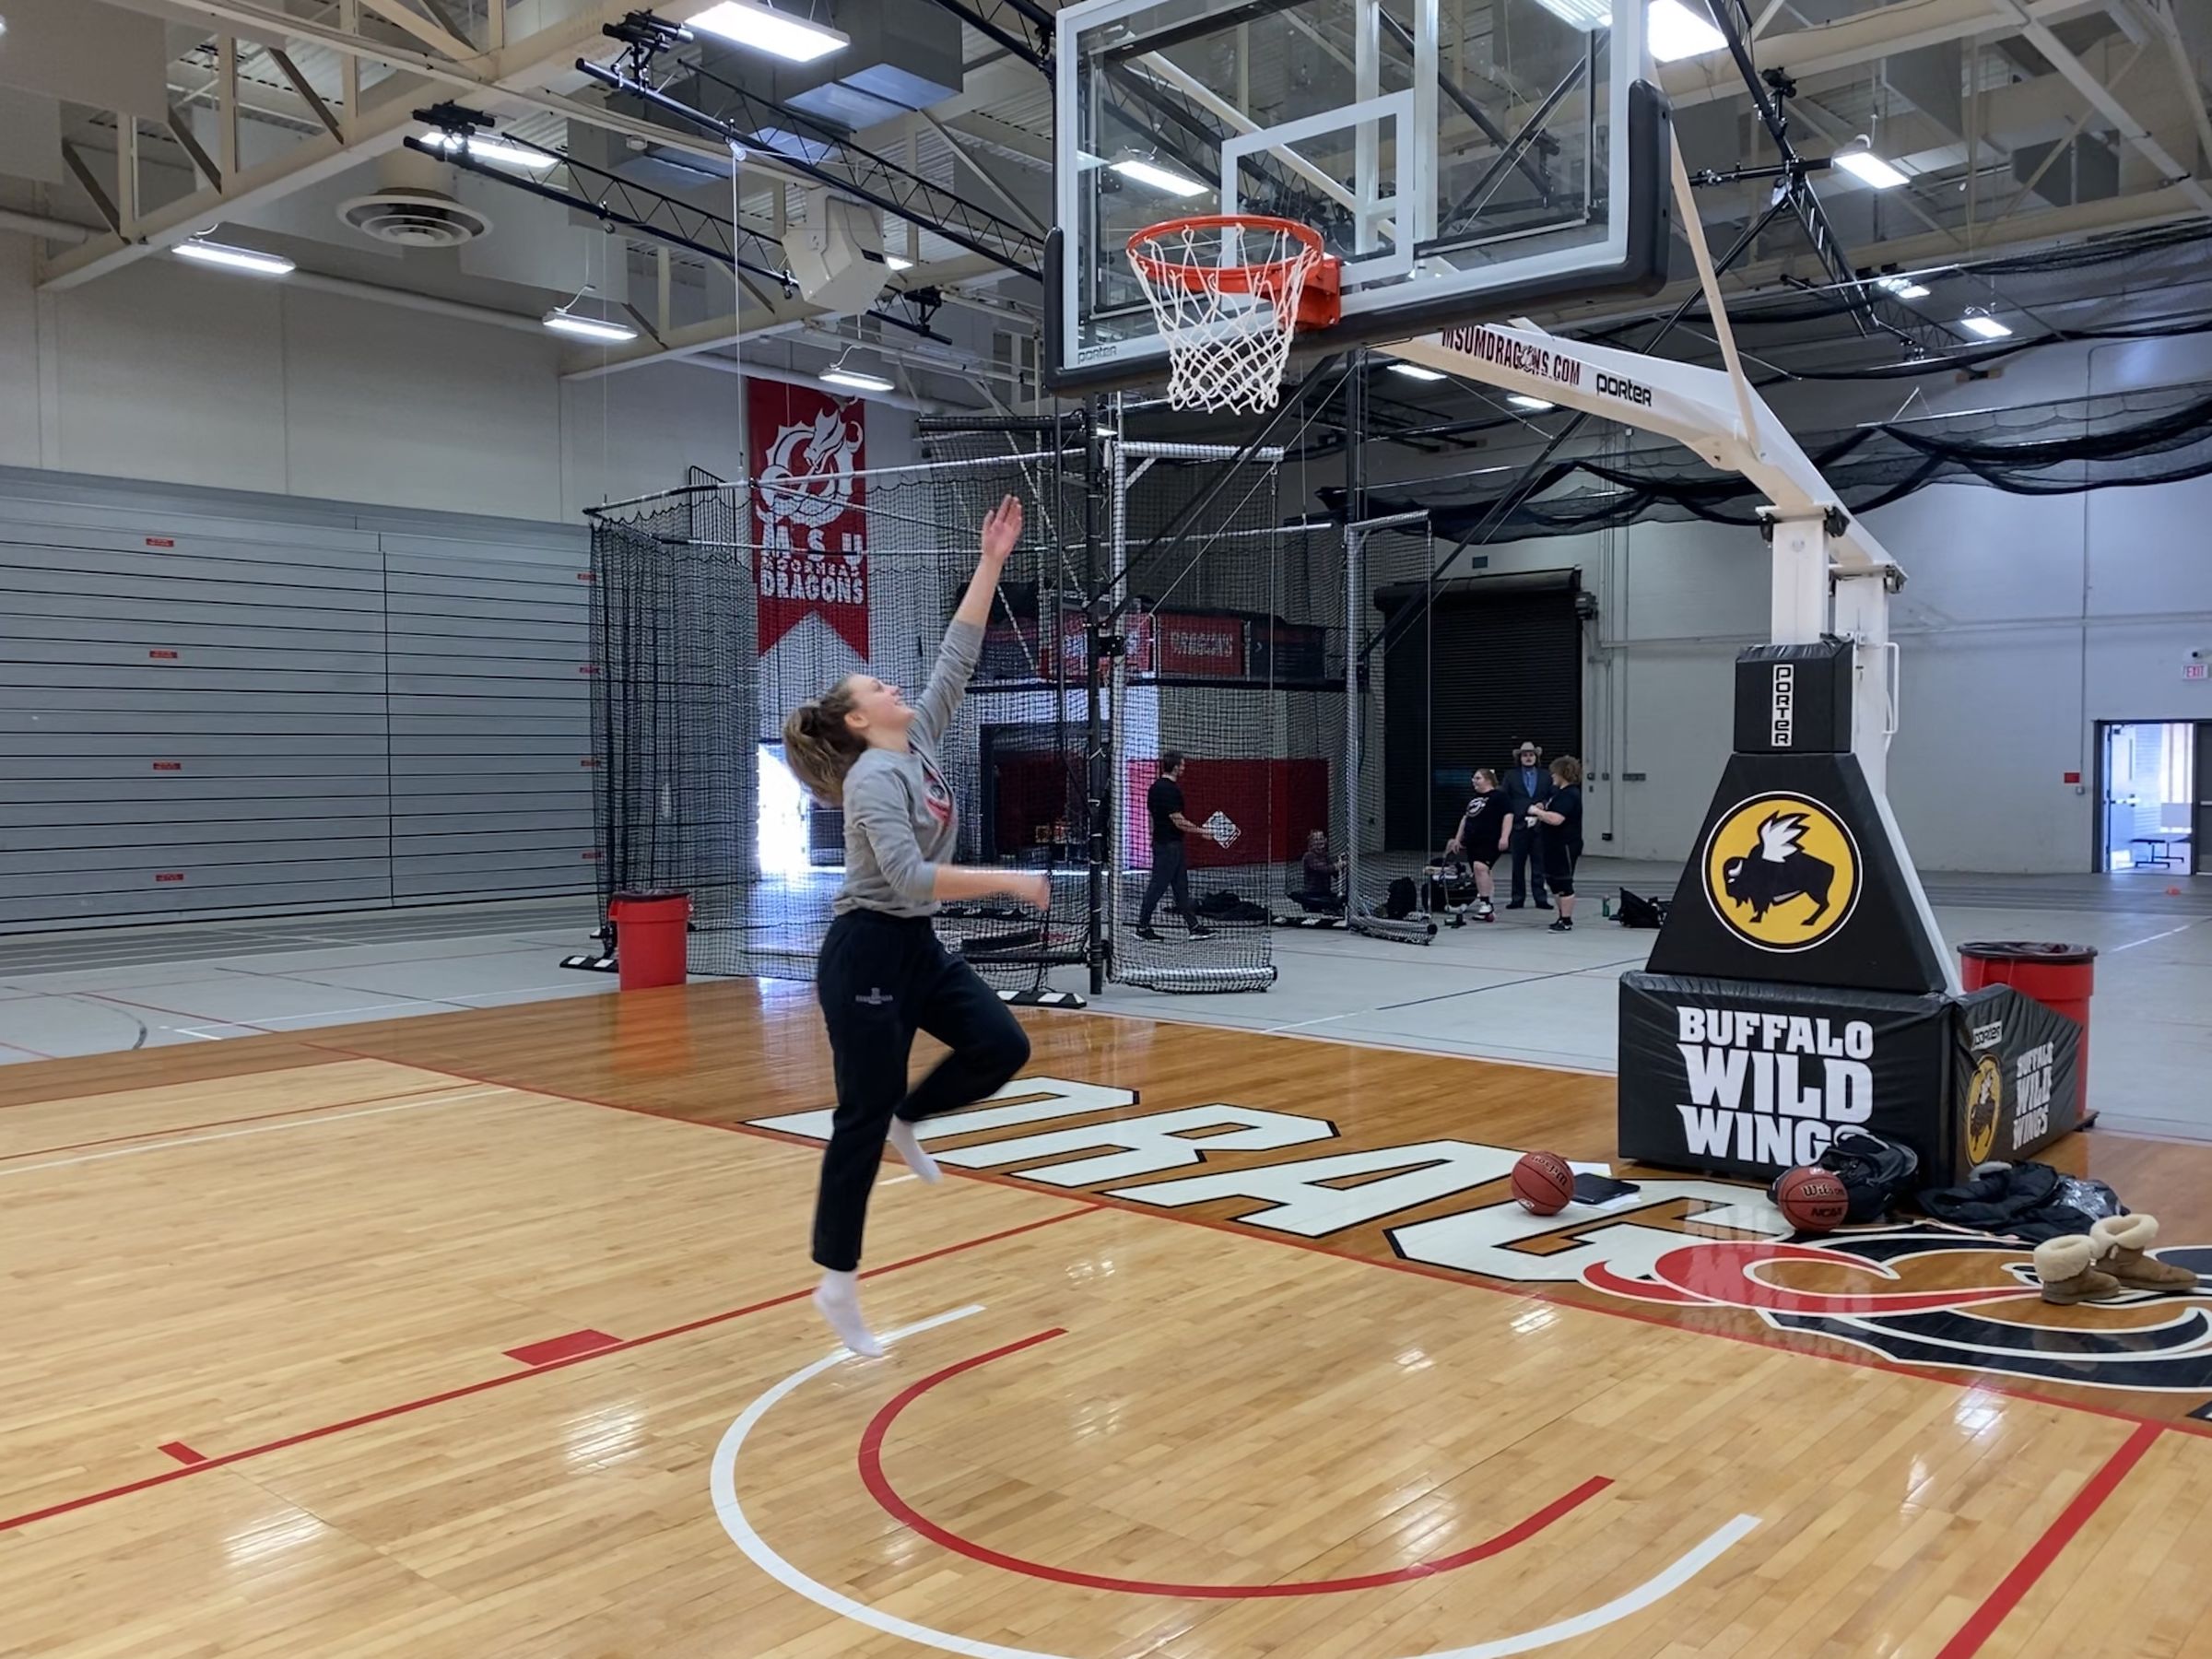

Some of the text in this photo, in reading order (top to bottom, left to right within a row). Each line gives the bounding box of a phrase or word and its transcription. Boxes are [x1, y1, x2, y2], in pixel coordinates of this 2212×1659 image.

[760, 571, 865, 605] DRAGONS
[2186, 665, 2205, 678] EXIT
[1677, 1006, 1874, 1060] BUFFALO
[1677, 1043, 1874, 1124] WILD
[2016, 1066, 2053, 1118] WILD
[2013, 1104, 2050, 1150] WINGS
[1531, 1155, 1569, 1187] Wilson
[1802, 1183, 1845, 1199] Wilson
[1810, 1206, 1842, 1218] NCAA
